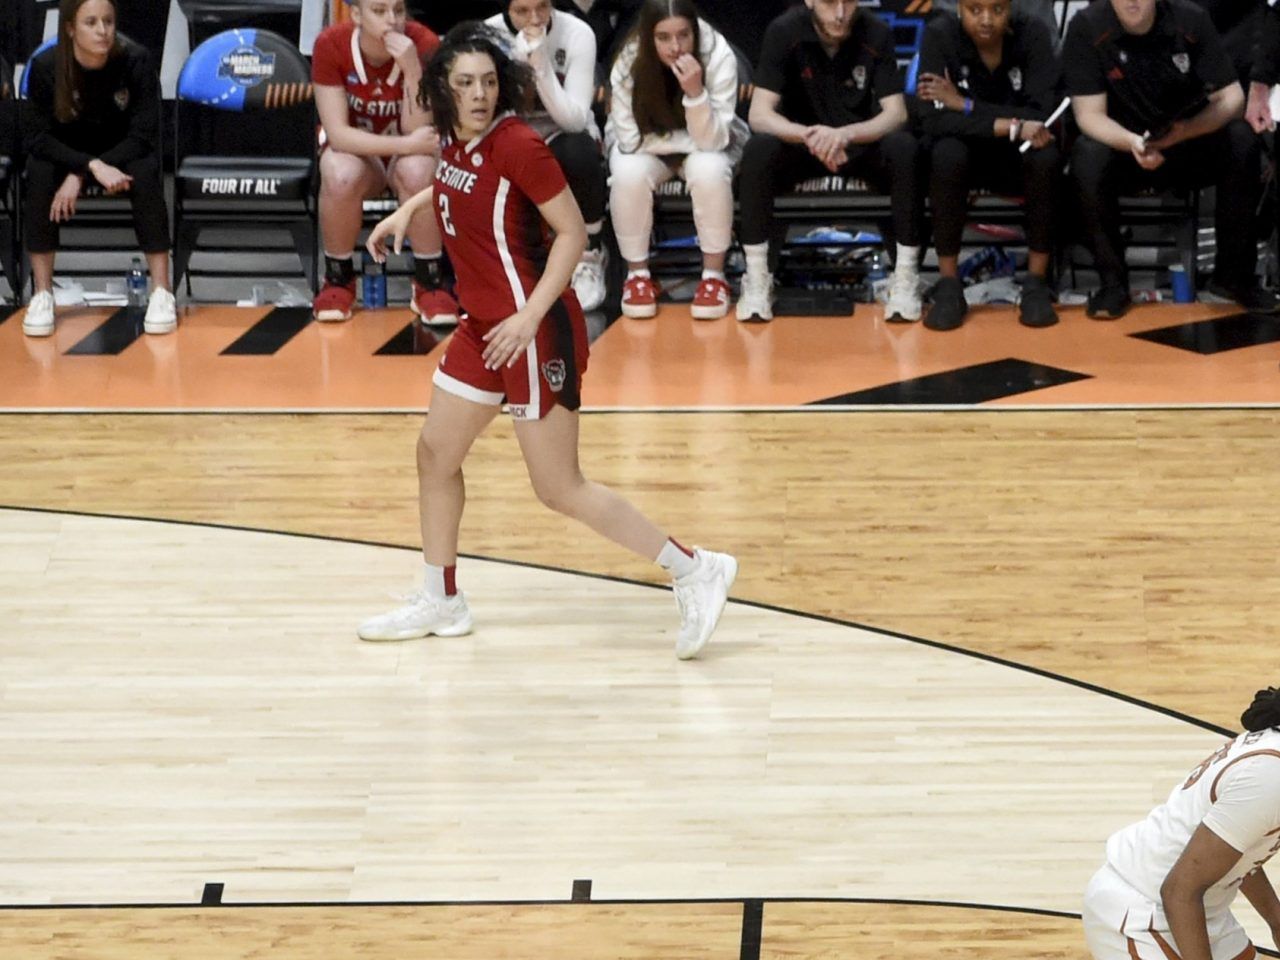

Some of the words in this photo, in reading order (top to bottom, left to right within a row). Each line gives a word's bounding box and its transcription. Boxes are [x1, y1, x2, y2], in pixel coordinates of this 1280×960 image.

[201, 178, 237, 194] FOUR
[239, 178, 254, 194] IT
[255, 179, 277, 195] ALL
[658, 180, 682, 196] OUR
[439, 192, 457, 237] 2
